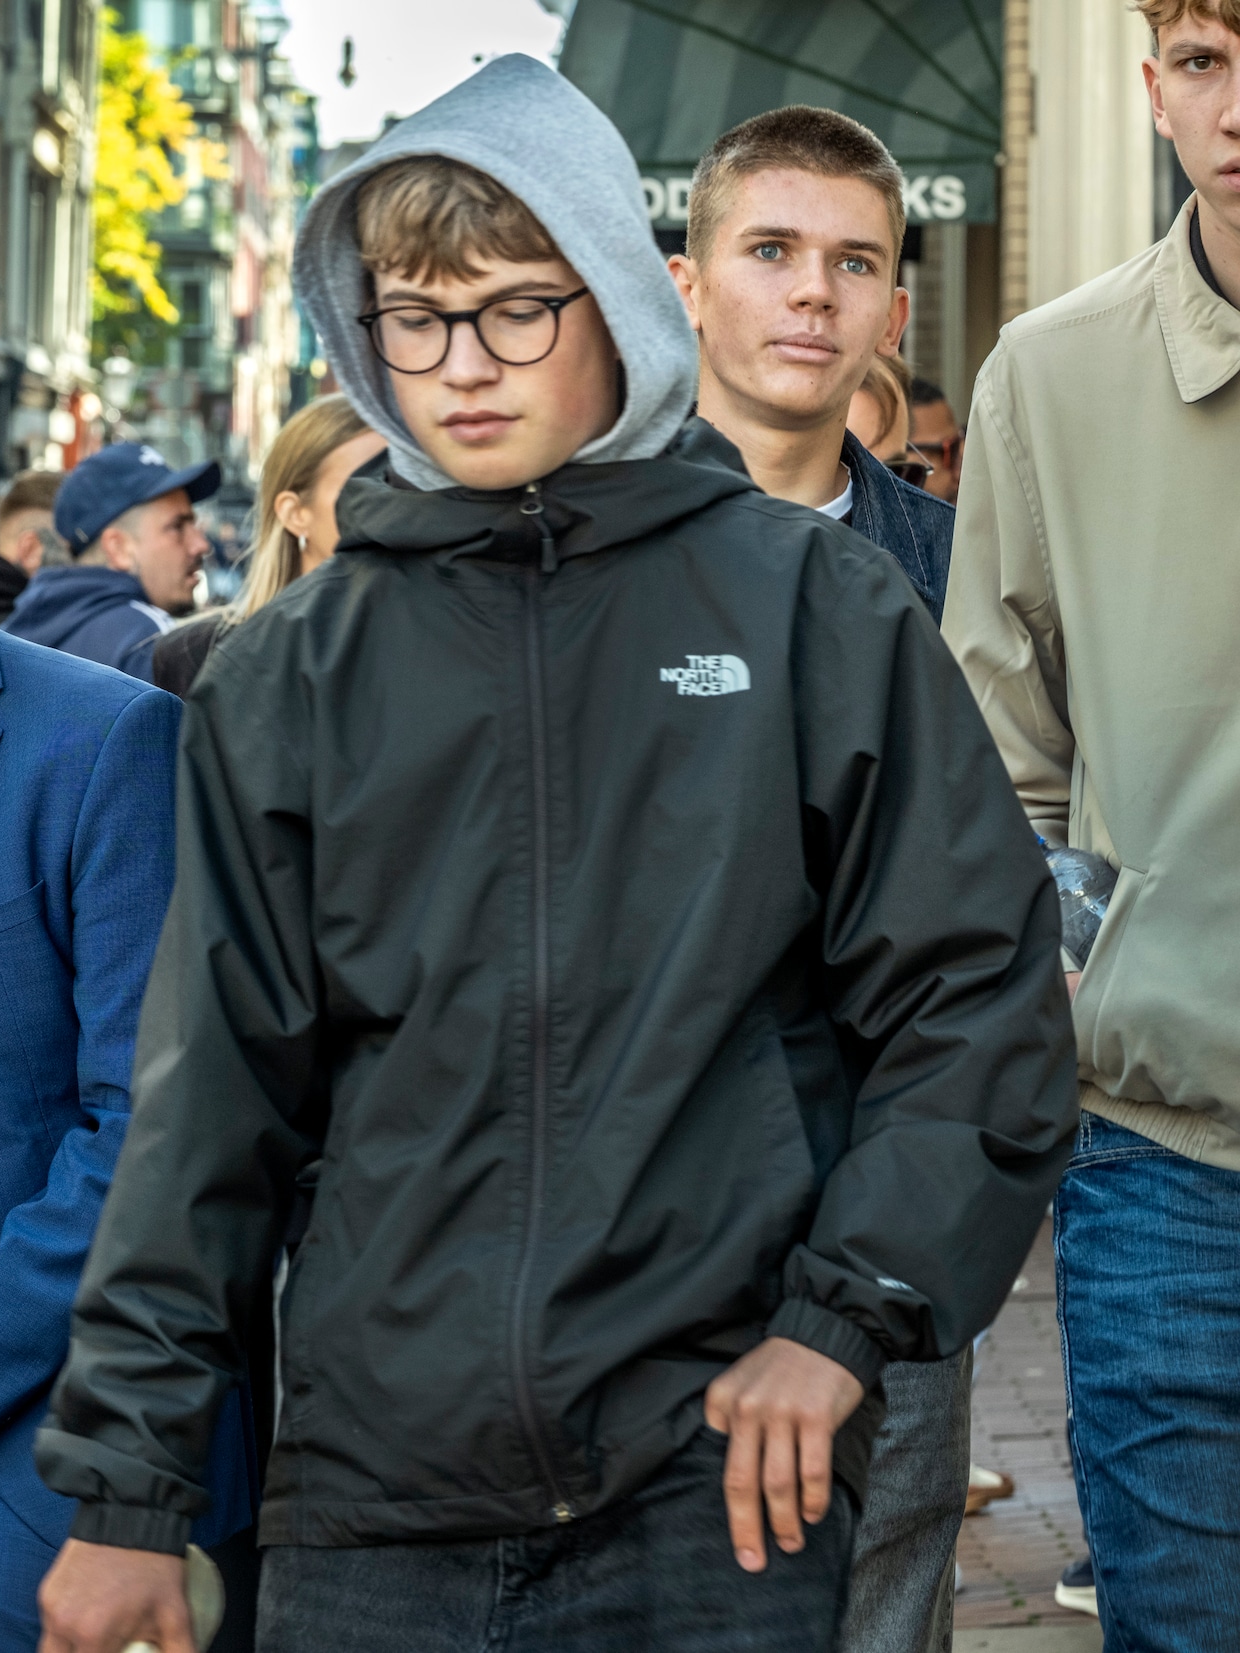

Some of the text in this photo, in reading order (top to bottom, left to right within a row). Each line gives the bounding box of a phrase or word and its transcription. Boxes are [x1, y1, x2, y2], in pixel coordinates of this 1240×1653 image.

[685, 655, 720, 669] THE
[660, 668, 719, 682] NORTH
[677, 681, 721, 696] FACE
